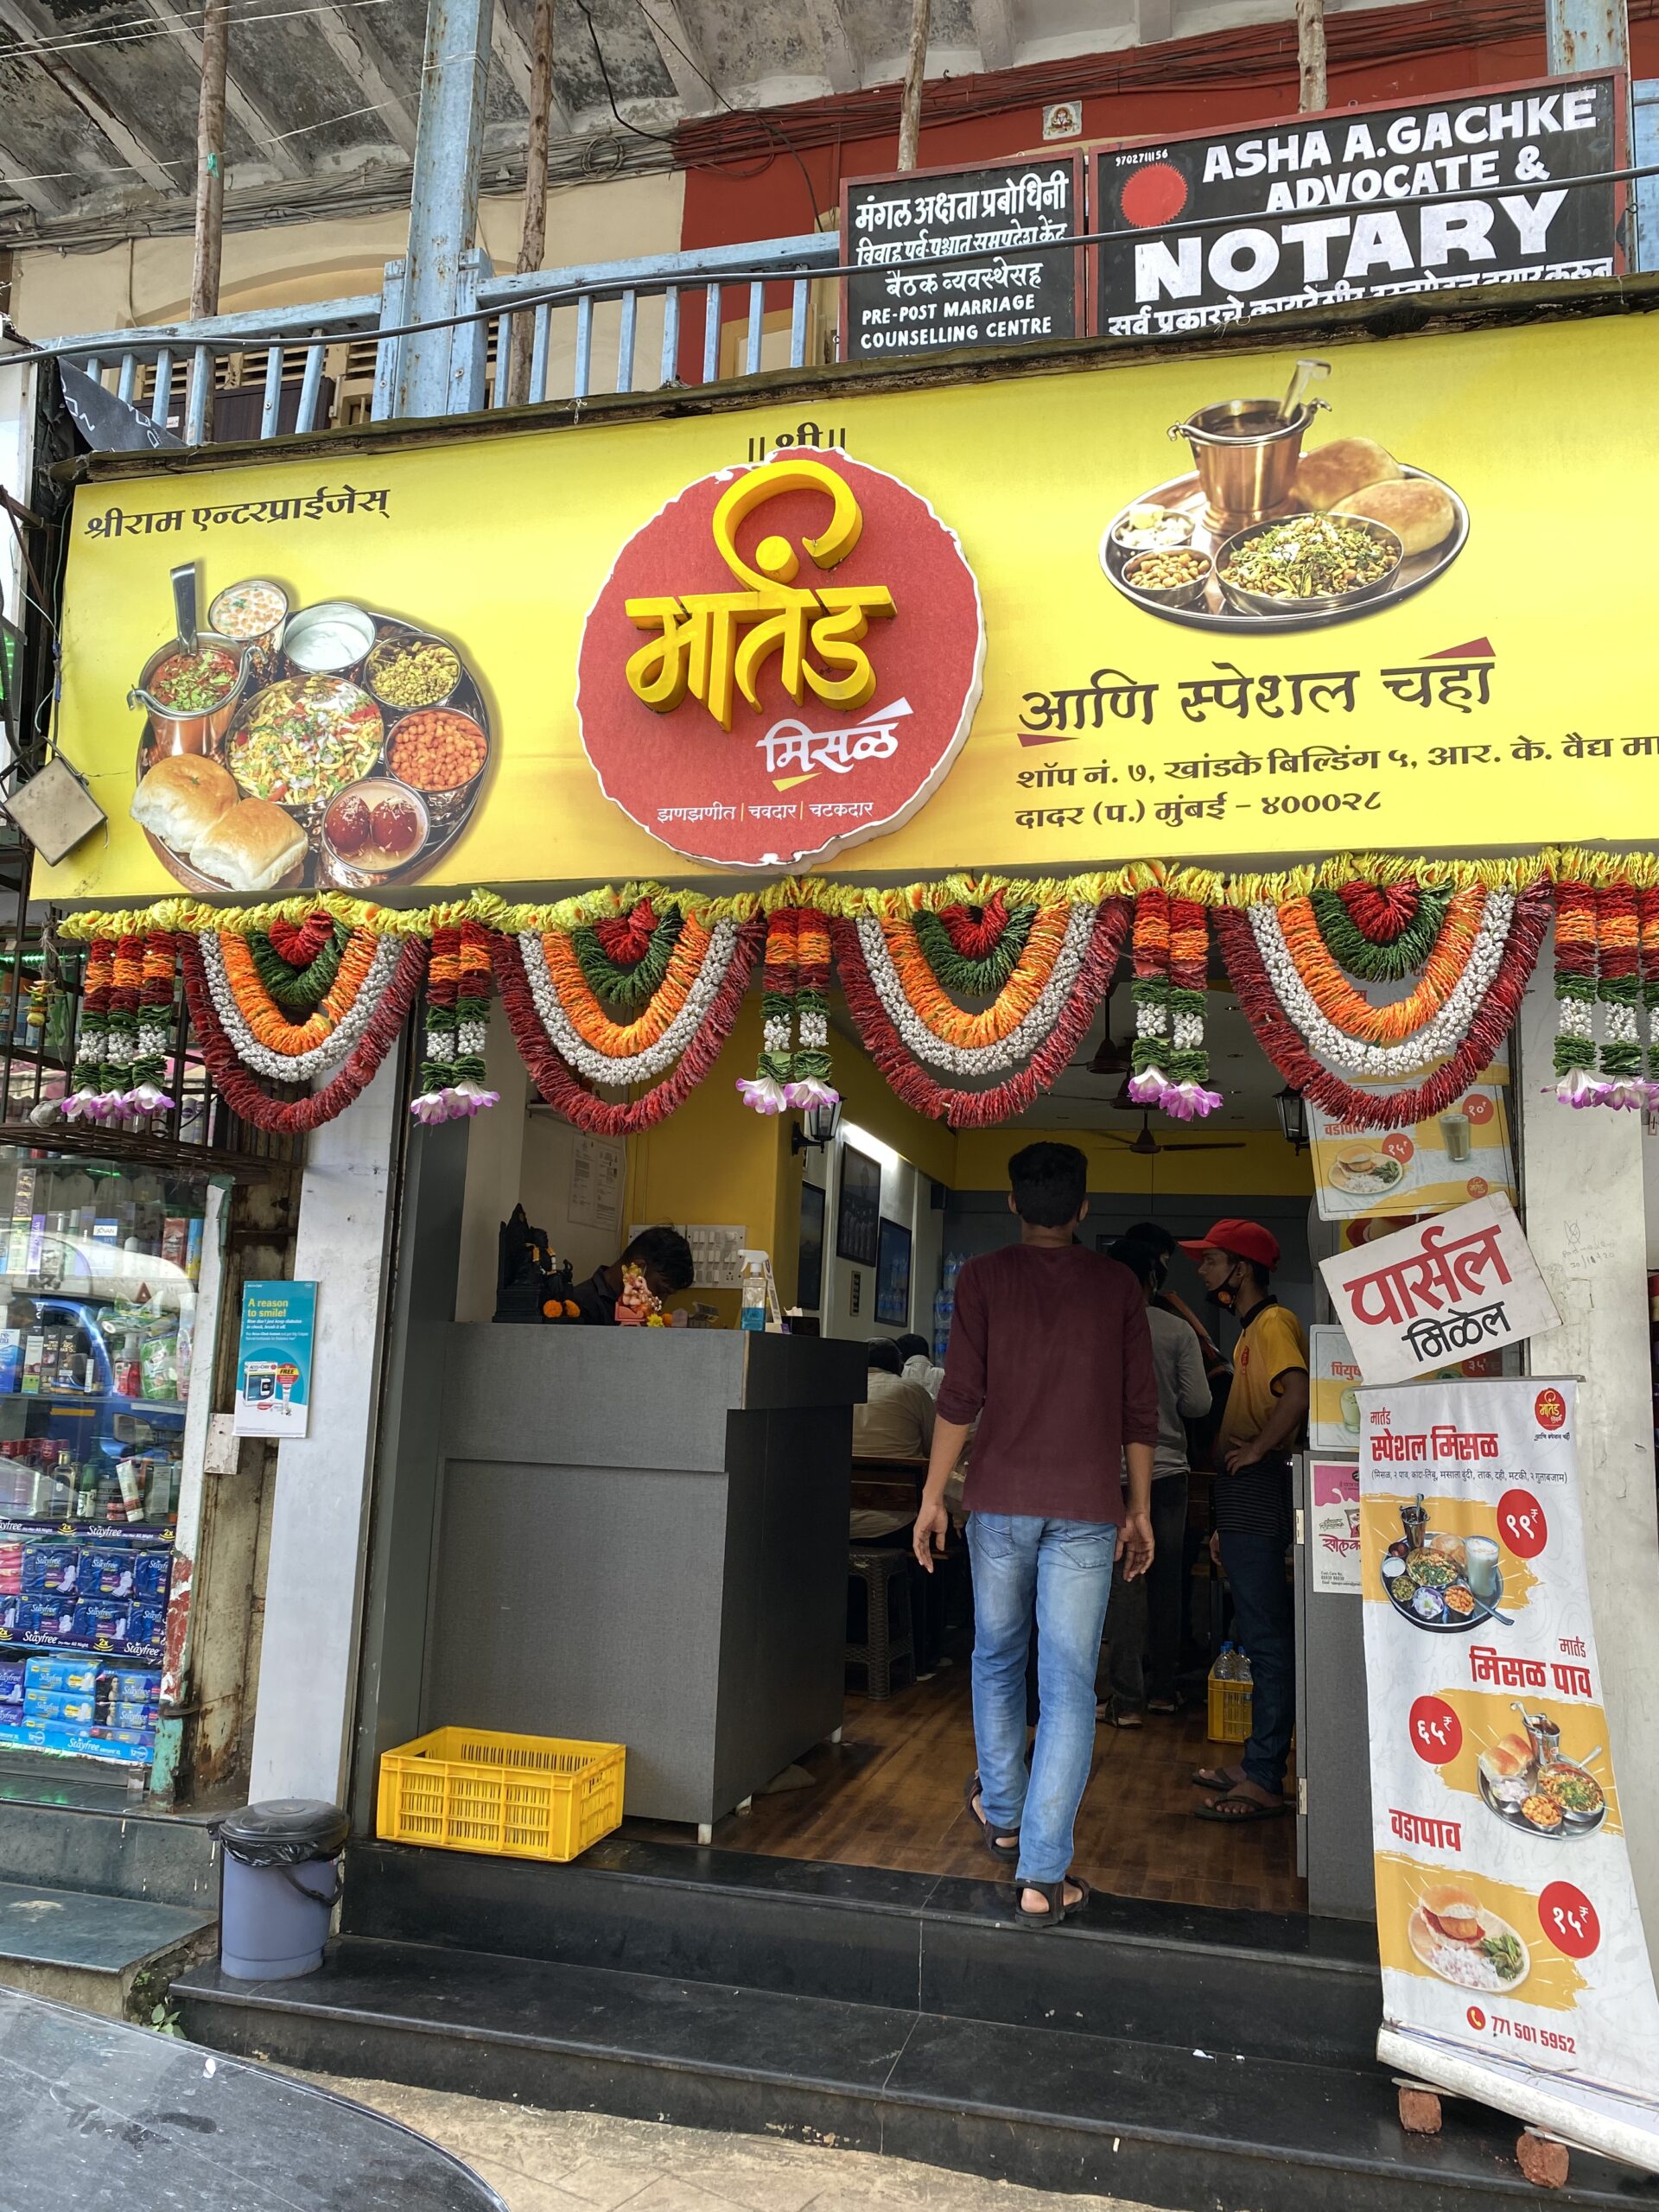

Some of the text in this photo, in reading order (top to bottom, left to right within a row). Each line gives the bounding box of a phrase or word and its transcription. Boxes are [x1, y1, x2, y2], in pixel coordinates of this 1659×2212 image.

[1202, 88, 1597, 182] ASHA A.GACHKE
[1116, 149, 1168, 166] 9702711156
[1267, 144, 1551, 212] ADVOCATE &
[855, 170, 1069, 232] मंगल अक्षता प्रबोधिनी
[856, 237, 903, 266] विवाह
[1135, 189, 1568, 302] NOTARY
[885, 257, 1044, 297] बैठक व्यवस्थेसह
[861, 294, 1035, 326] PRE-POST MARRIAGE
[860, 316, 1052, 349] COUNSELLING CENTRE
[84, 507, 185, 539] श्रीराम
[1019, 661, 1497, 733] आणि स्पेशल चहा
[755, 718, 899, 774] मिसळ
[1016, 760, 1077, 790] शॉप
[1164, 747, 1263, 782] खांडके
[1268, 743, 1380, 776] बिल्डिंग
[1427, 743, 1502, 766] आर.
[1512, 734, 1553, 762] के.
[1563, 731, 1613, 760] वैद्य
[657, 801, 874, 823] झणझणीत चवदार चटकदार
[1015, 804, 1085, 830] दादर
[1093, 800, 1147, 827] (प.)
[1154, 792, 1229, 827] मुंबई
[1261, 791, 1382, 817] ४०००२८
[1343, 1225, 1512, 1325] पार्सल
[248, 1298, 289, 1307] A reason
[248, 1308, 286, 1318] to smile!
[1402, 1300, 1511, 1362] मिळेल
[1370, 1425, 1499, 1461] स्पेशल मिसळ
[87, 1525, 123, 1538] Stayfree
[22, 1630, 58, 1645] Stayfree
[124, 1642, 161, 1657] Stayfree
[1469, 1645, 1592, 1698] मिसळ पाव
[67, 1737, 100, 1751] Stayfree
[1389, 1808, 1461, 1852] वडापाव
[1491, 2015, 1576, 2055] 771 501 5952
